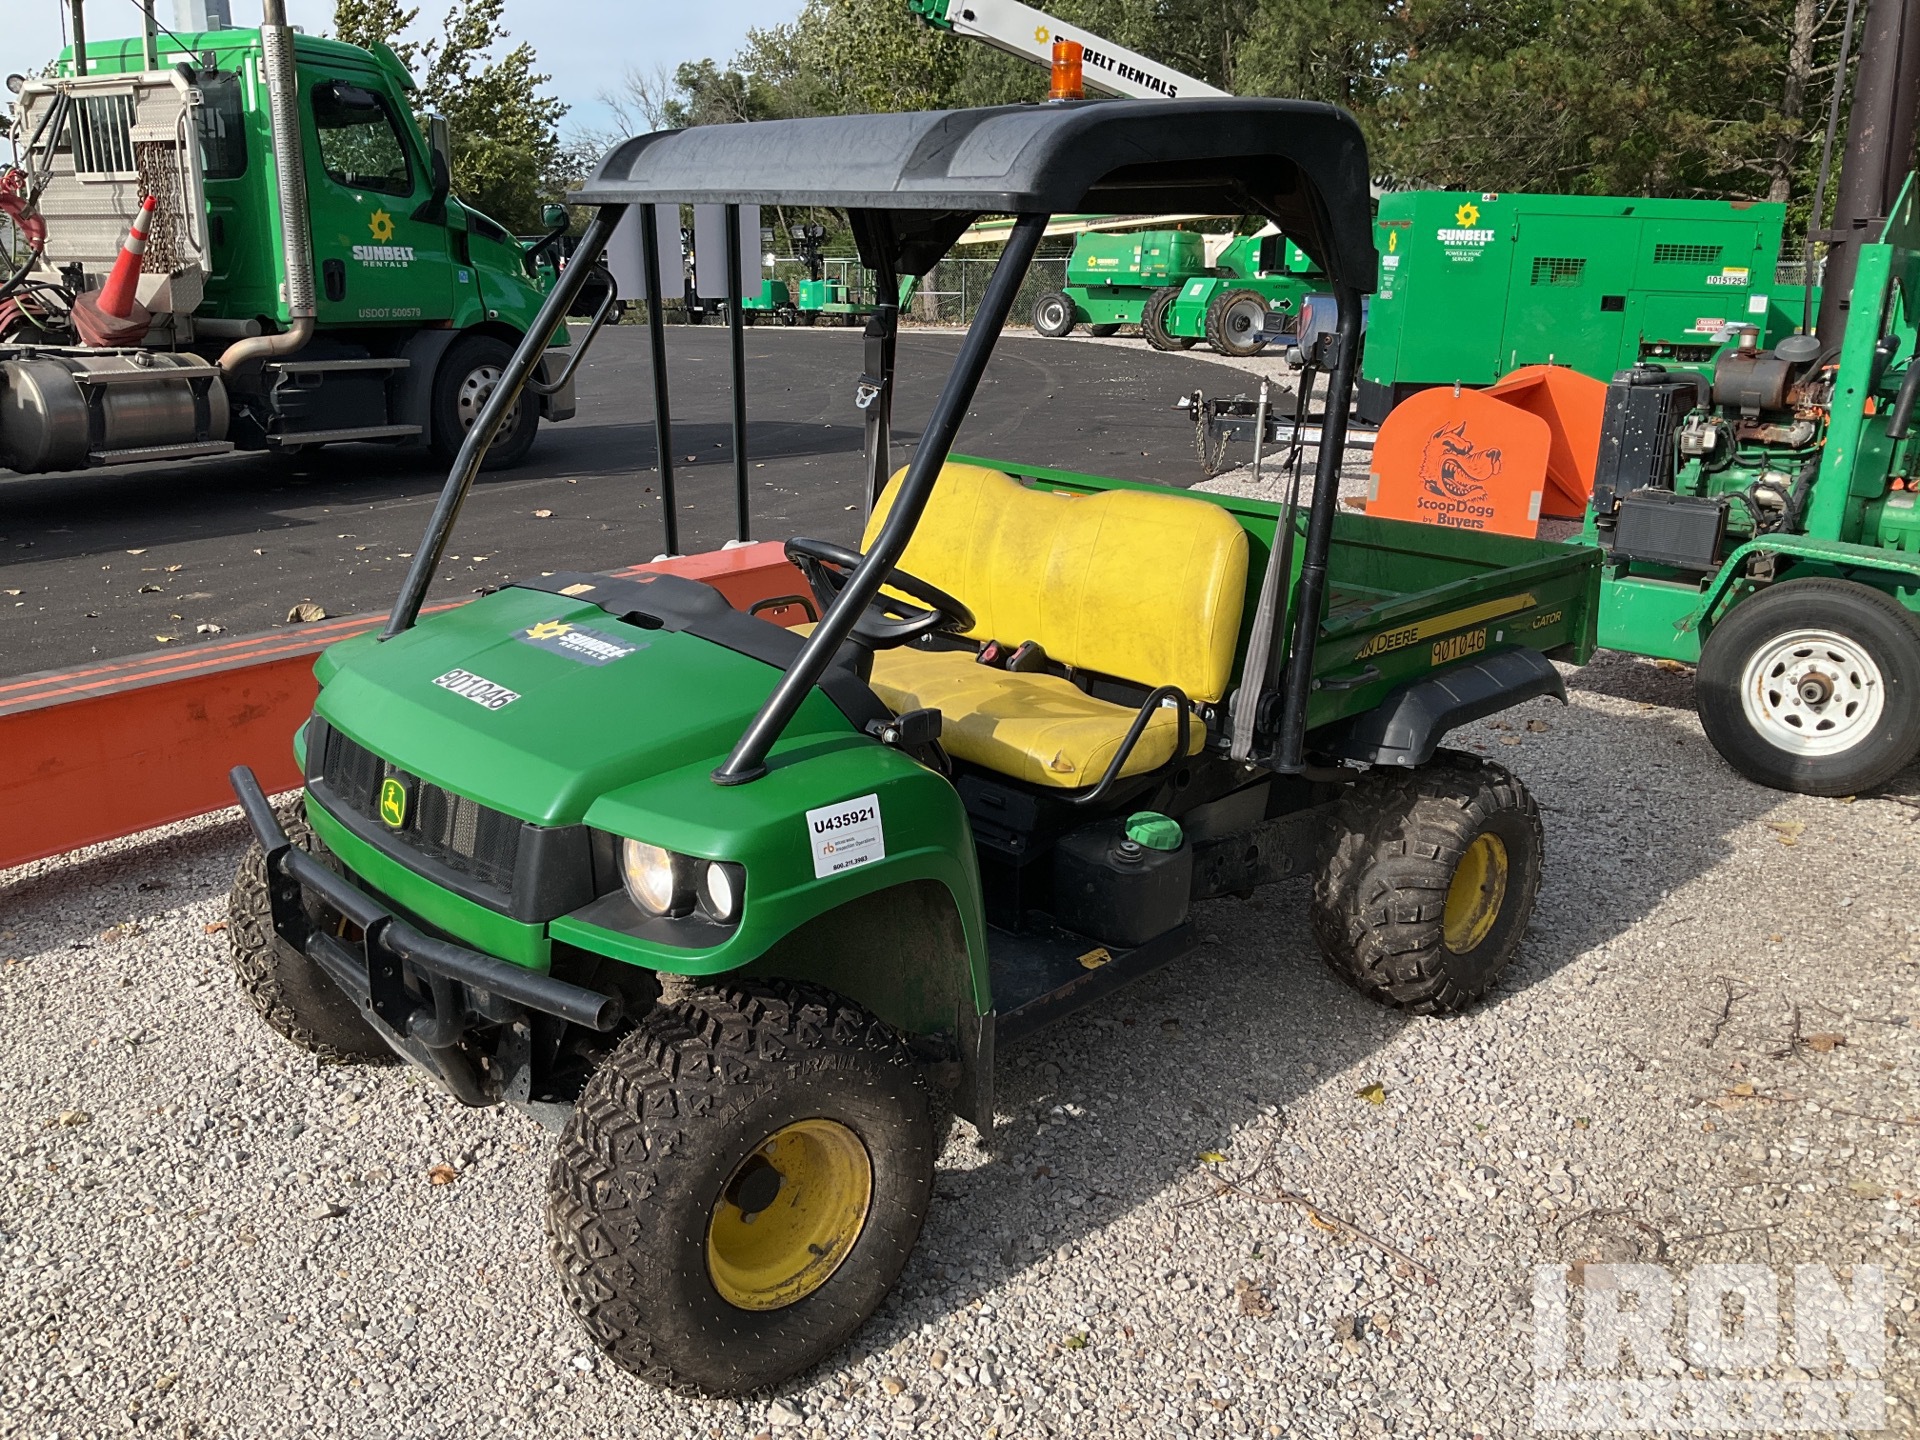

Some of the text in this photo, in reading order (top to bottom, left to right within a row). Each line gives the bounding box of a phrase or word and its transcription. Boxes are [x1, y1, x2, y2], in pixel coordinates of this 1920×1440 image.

[1117, 62, 1178, 98] RENTALS
[1437, 229, 1494, 241] SUNBELT
[352, 245, 414, 260] SUNBELT
[1707, 276, 1747, 285] 10151254
[358, 308, 421, 318] USDOT 500579
[1417, 497, 1494, 517] ScoopDogg
[1423, 512, 1485, 529] by Buyers
[1533, 611, 1562, 630] GATOR
[1377, 628, 1419, 651] DEERE
[1433, 629, 1485, 663] 901046
[435, 669, 517, 709] 901046
[814, 807, 874, 833] U435921
